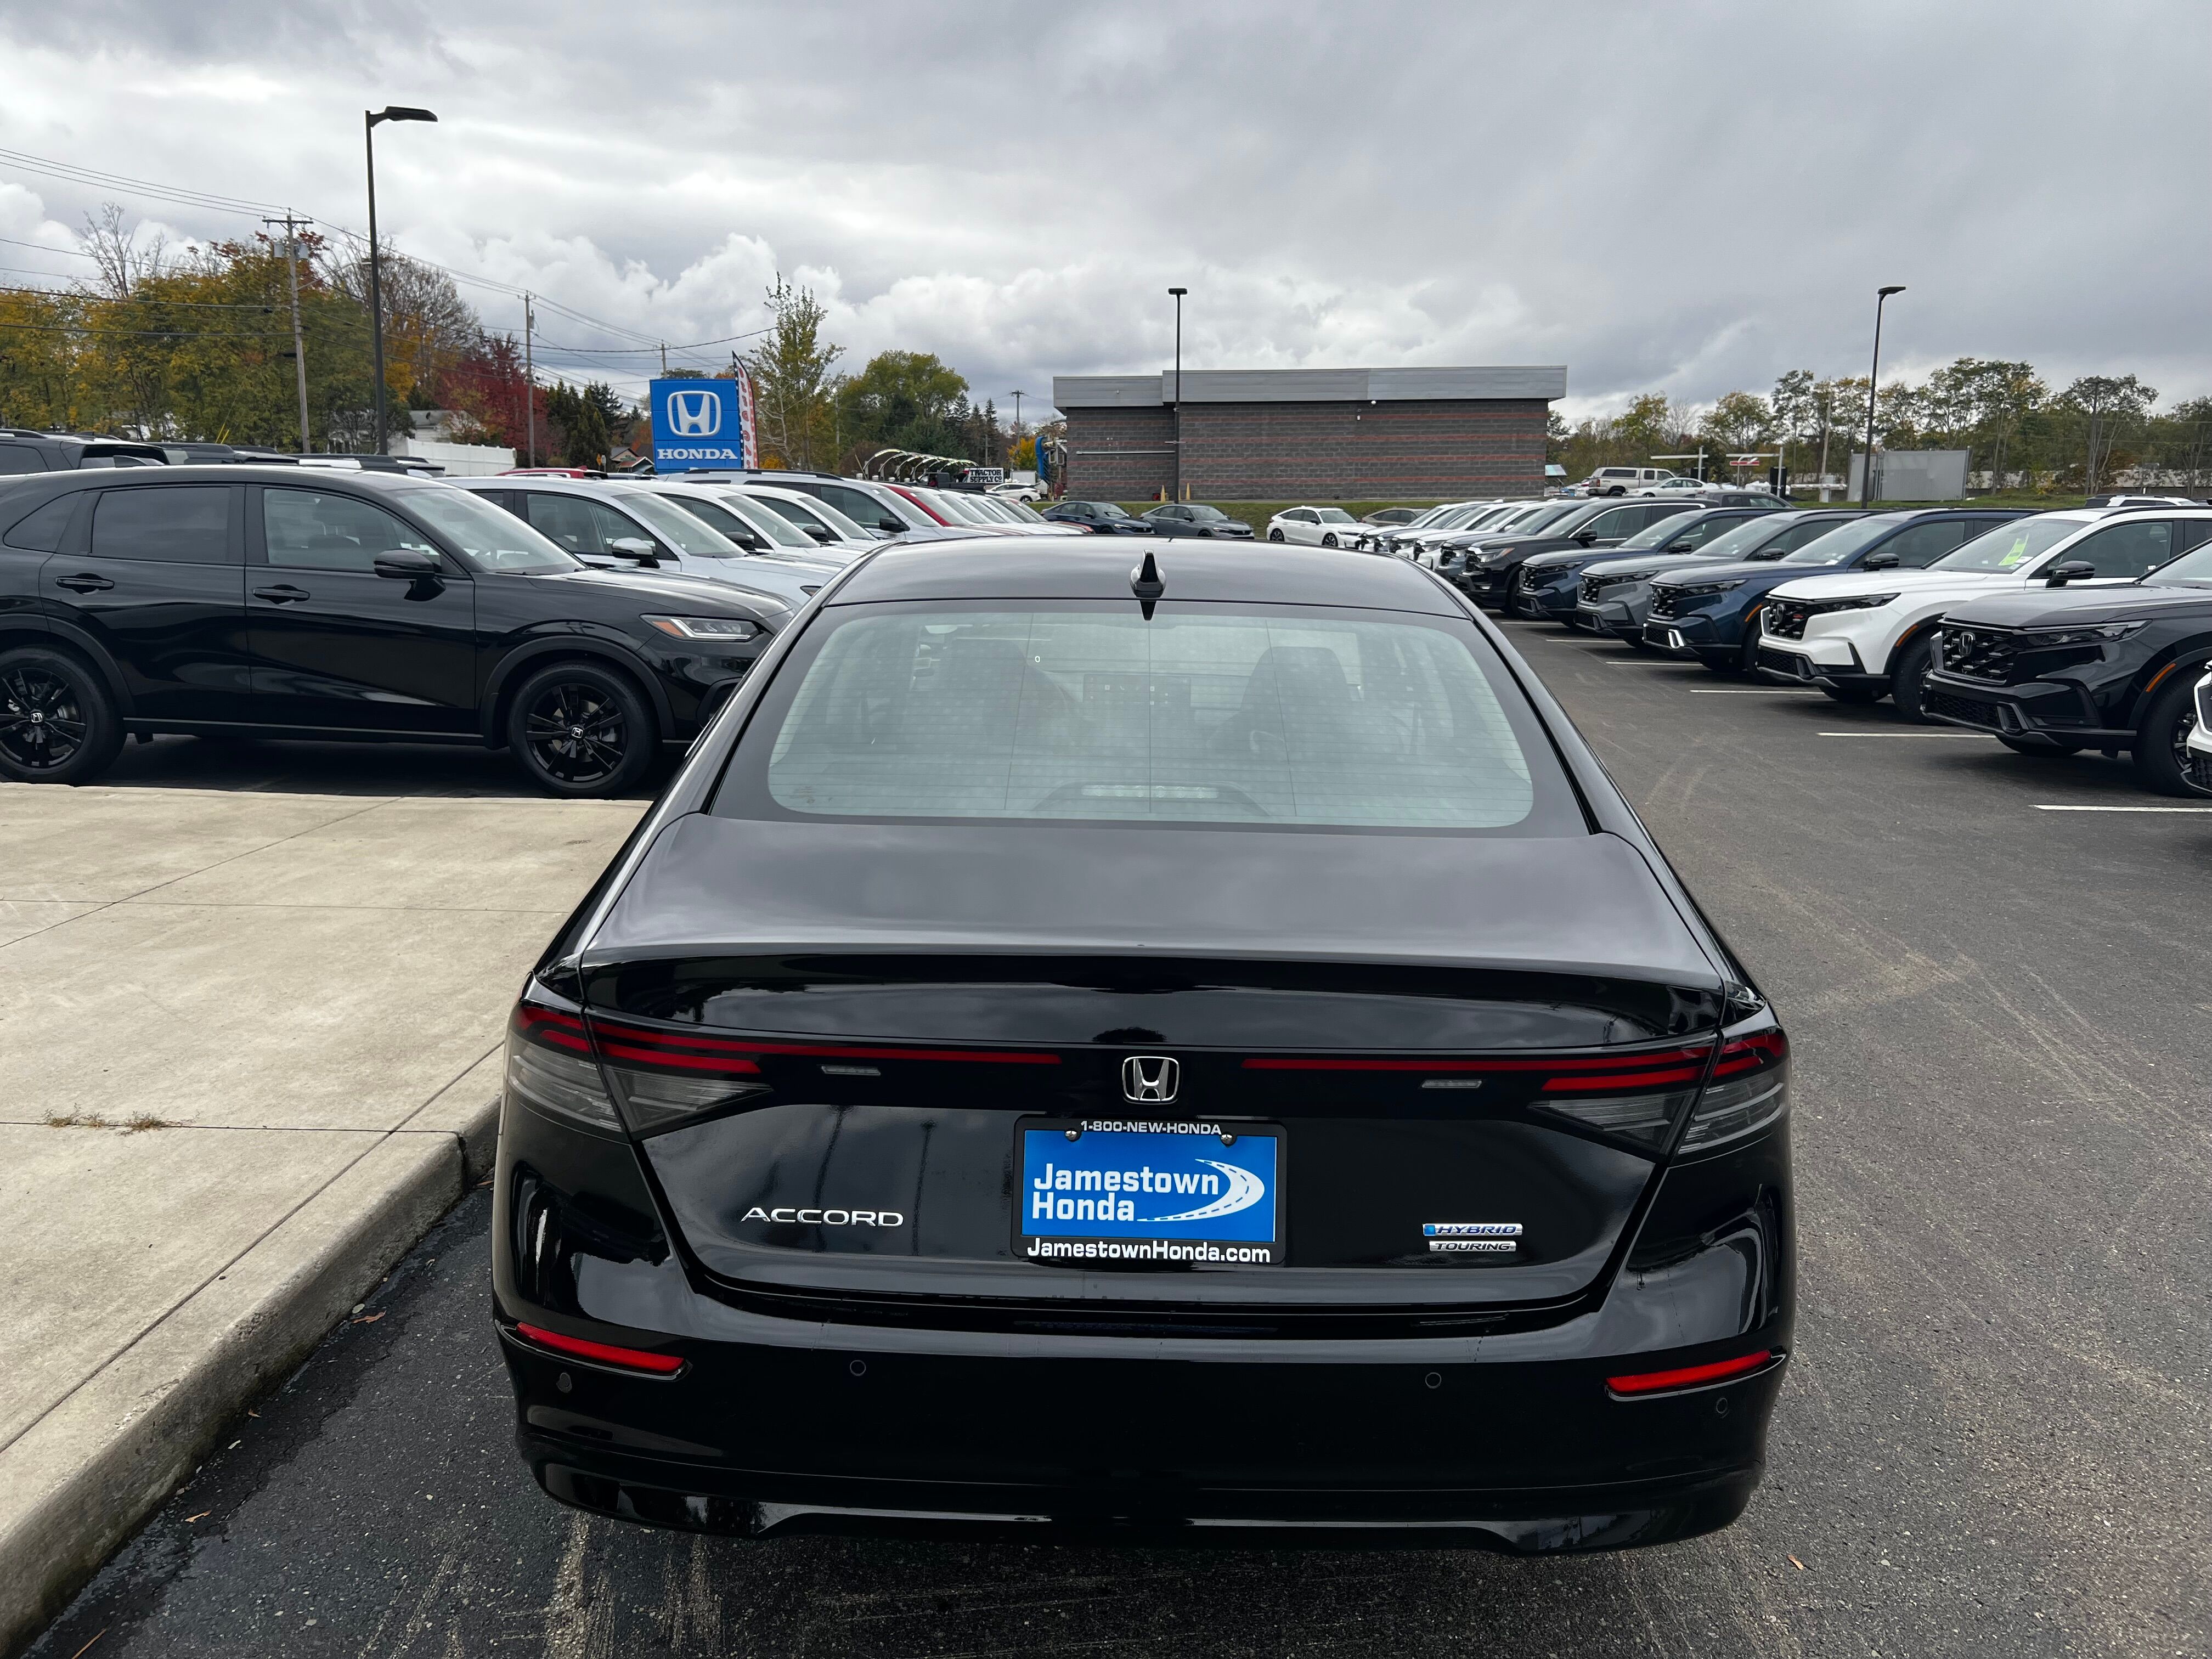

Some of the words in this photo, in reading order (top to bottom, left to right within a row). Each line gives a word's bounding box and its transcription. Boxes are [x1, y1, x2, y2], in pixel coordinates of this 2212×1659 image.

[657, 448, 738, 460] HONDA
[1080, 1120, 1222, 1136] 1-800-NEW-HONDA
[1034, 1163, 1220, 1195] Jamestown
[1032, 1191, 1135, 1222] Honda
[740, 1206, 904, 1228] ACCORD
[1437, 1226, 1517, 1234] HYBRID
[1027, 1237, 1271, 1263] JamestownHonda.com
[1435, 1243, 1511, 1251] TOURING
